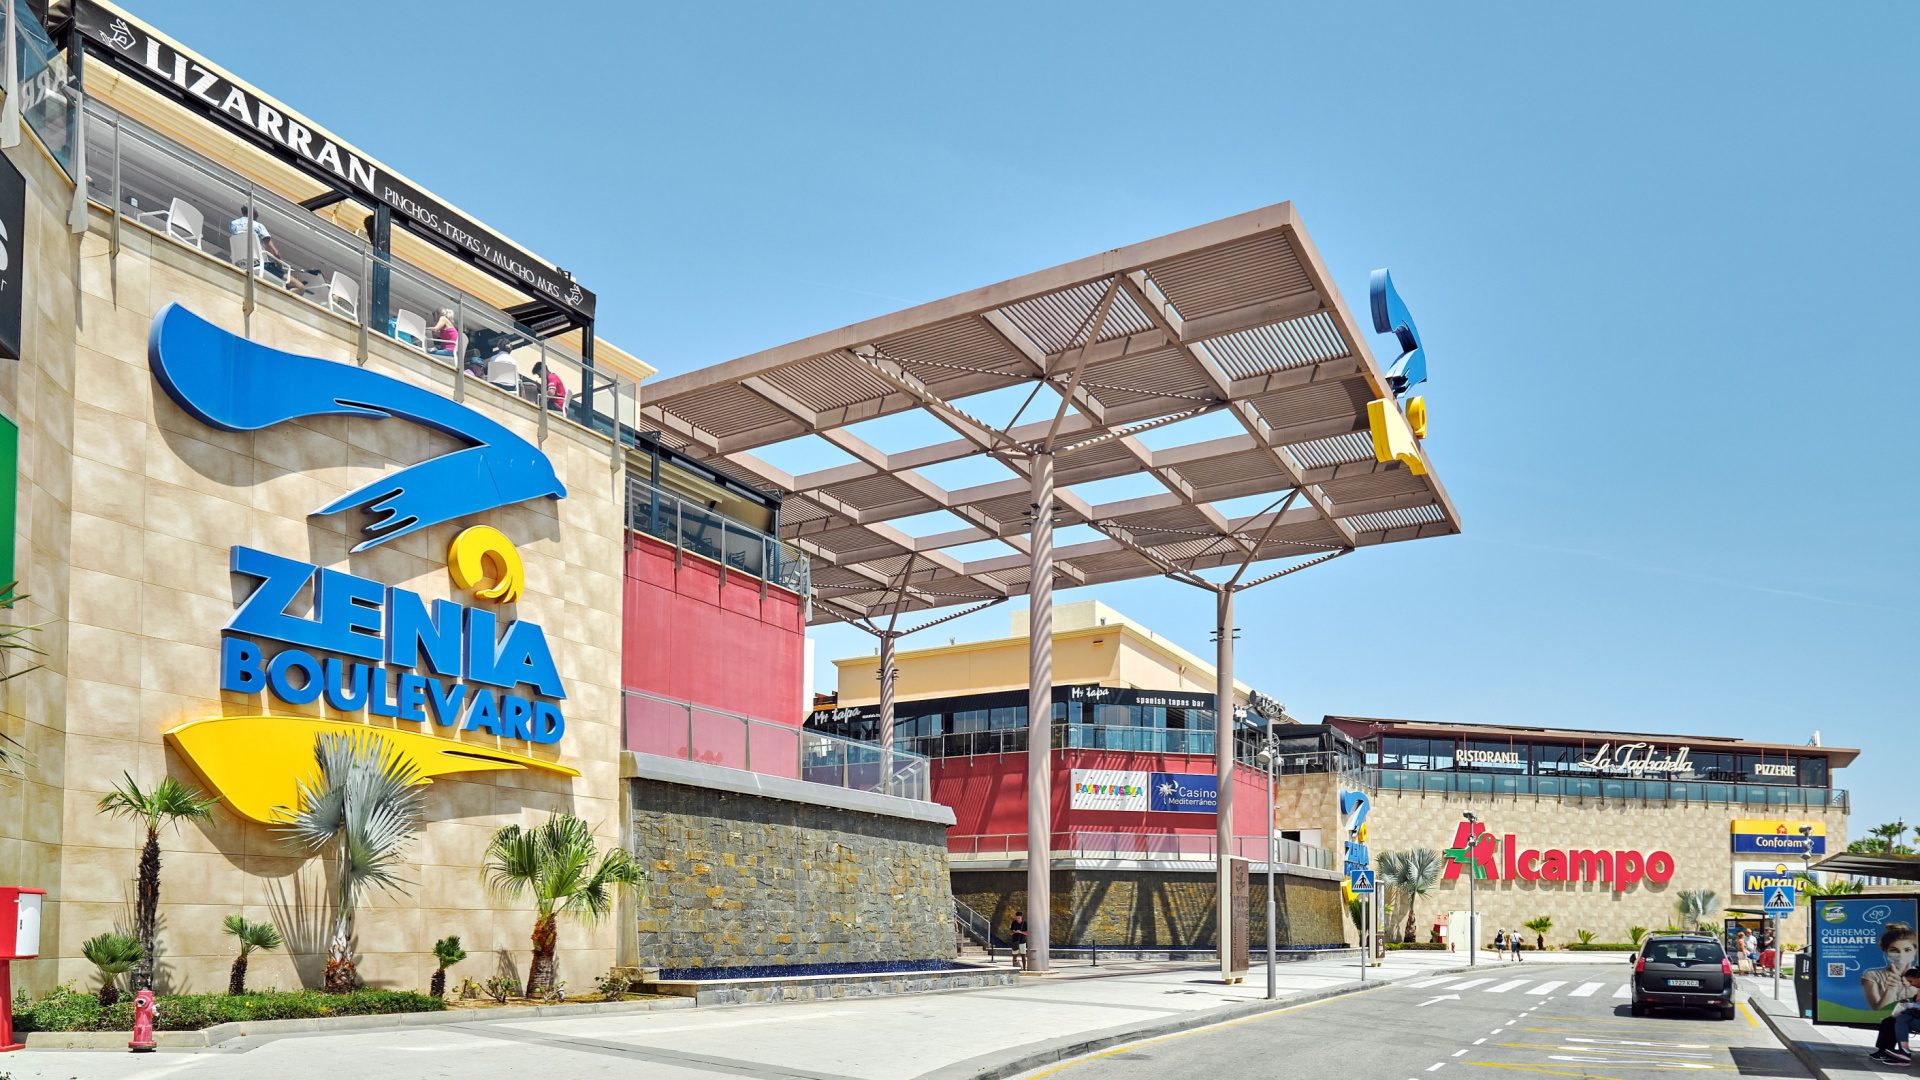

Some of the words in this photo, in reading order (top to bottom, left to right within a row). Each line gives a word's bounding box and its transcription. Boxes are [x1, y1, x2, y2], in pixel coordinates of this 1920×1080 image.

[146, 36, 377, 193] LIZARRAN
[384, 186, 442, 233] PINCHOS,
[443, 220, 481, 252] TAPAS
[482, 243, 491, 257] Y
[493, 250, 535, 283] MUCHO
[222, 545, 567, 699] ZENIA
[220, 636, 565, 744] BOULEVARD
[1086, 686, 1110, 700] tapa
[1136, 696, 1166, 706] spanish
[1169, 698, 1190, 707] tapas
[1192, 700, 1205, 708] bar
[832, 707, 862, 723] tapa
[1455, 749, 1519, 765] RISTORANTI
[1578, 743, 1612, 770] La
[1612, 742, 1694, 775] Tagliatella
[1754, 763, 1796, 777] PIZZERIE
[1075, 783, 1107, 794] PARTY
[1109, 785, 1143, 797] FIESTA
[1179, 787, 1217, 798] Casino
[1168, 796, 1217, 806] Mediterráneo
[1756, 836, 1803, 848] Conforam
[1442, 821, 1675, 892] Alcampo
[1747, 875, 1808, 892] Noraut
[1821, 928, 1876, 937] QUEREMOS
